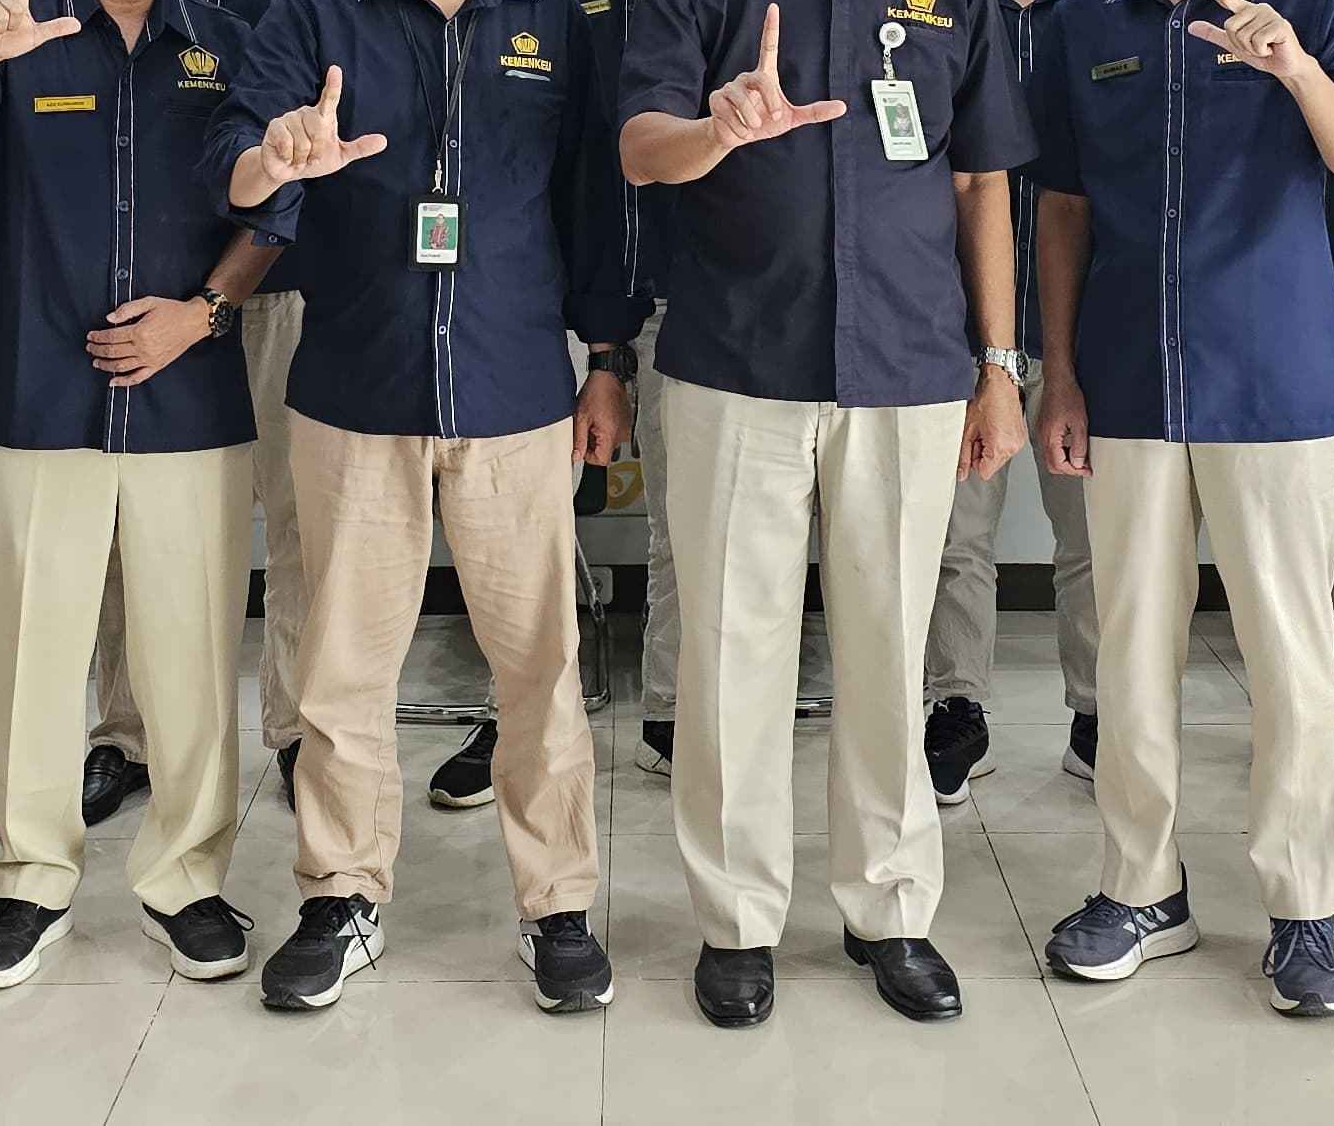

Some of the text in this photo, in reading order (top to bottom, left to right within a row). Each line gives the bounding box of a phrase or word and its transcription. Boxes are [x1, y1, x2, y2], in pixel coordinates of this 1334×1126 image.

[887, 6, 953, 28] KEMENKEU
[500, 54, 552, 72] KEMENKEU
[177, 79, 226, 92] KEMENKEU
